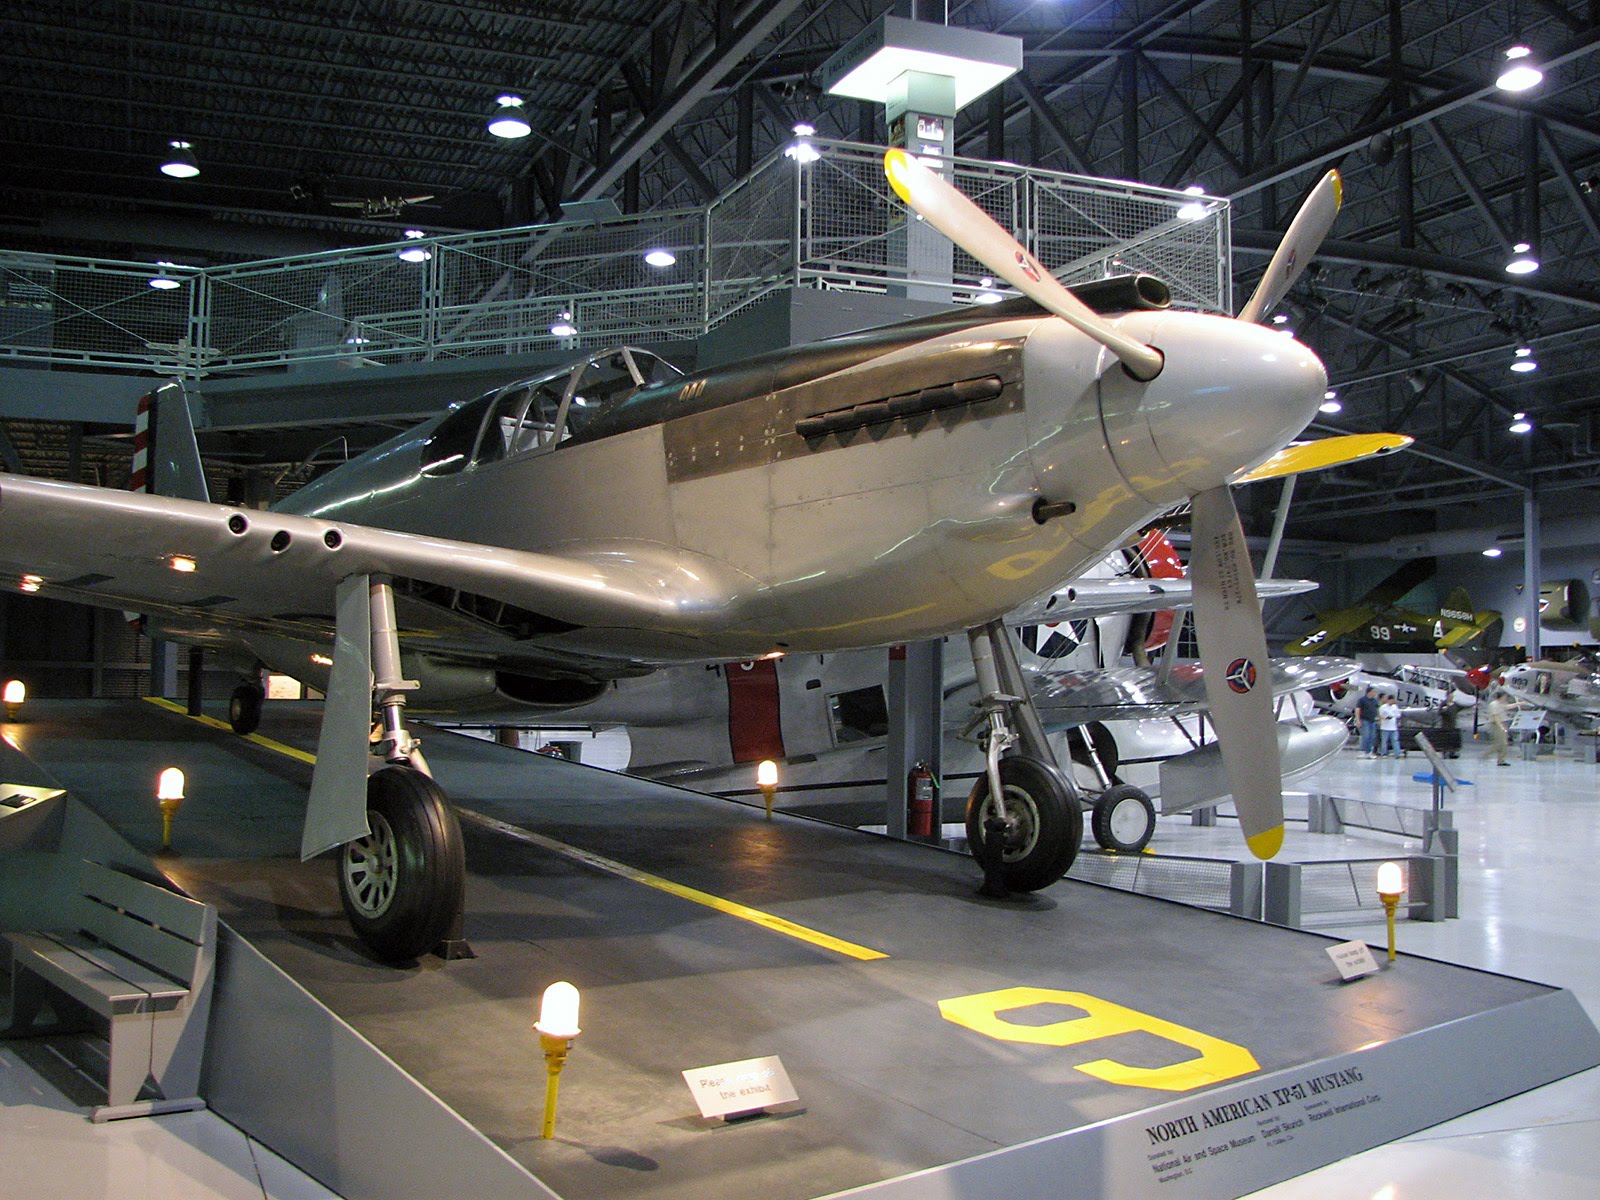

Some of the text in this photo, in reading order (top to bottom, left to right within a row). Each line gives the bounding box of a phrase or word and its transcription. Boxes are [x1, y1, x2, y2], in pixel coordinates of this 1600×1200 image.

[1370, 625, 1390, 640] 99
[937, 986, 1261, 1092] 9
[720, 1090, 736, 1100] the
[1145, 1067, 1364, 1145] NORTH AMERICAN XP-51 MUSTANG
[1308, 1108, 1334, 1122] Rockwell
[1335, 1098, 1366, 1114] International
[1152, 1135, 1256, 1173] National Air and Space Museum
